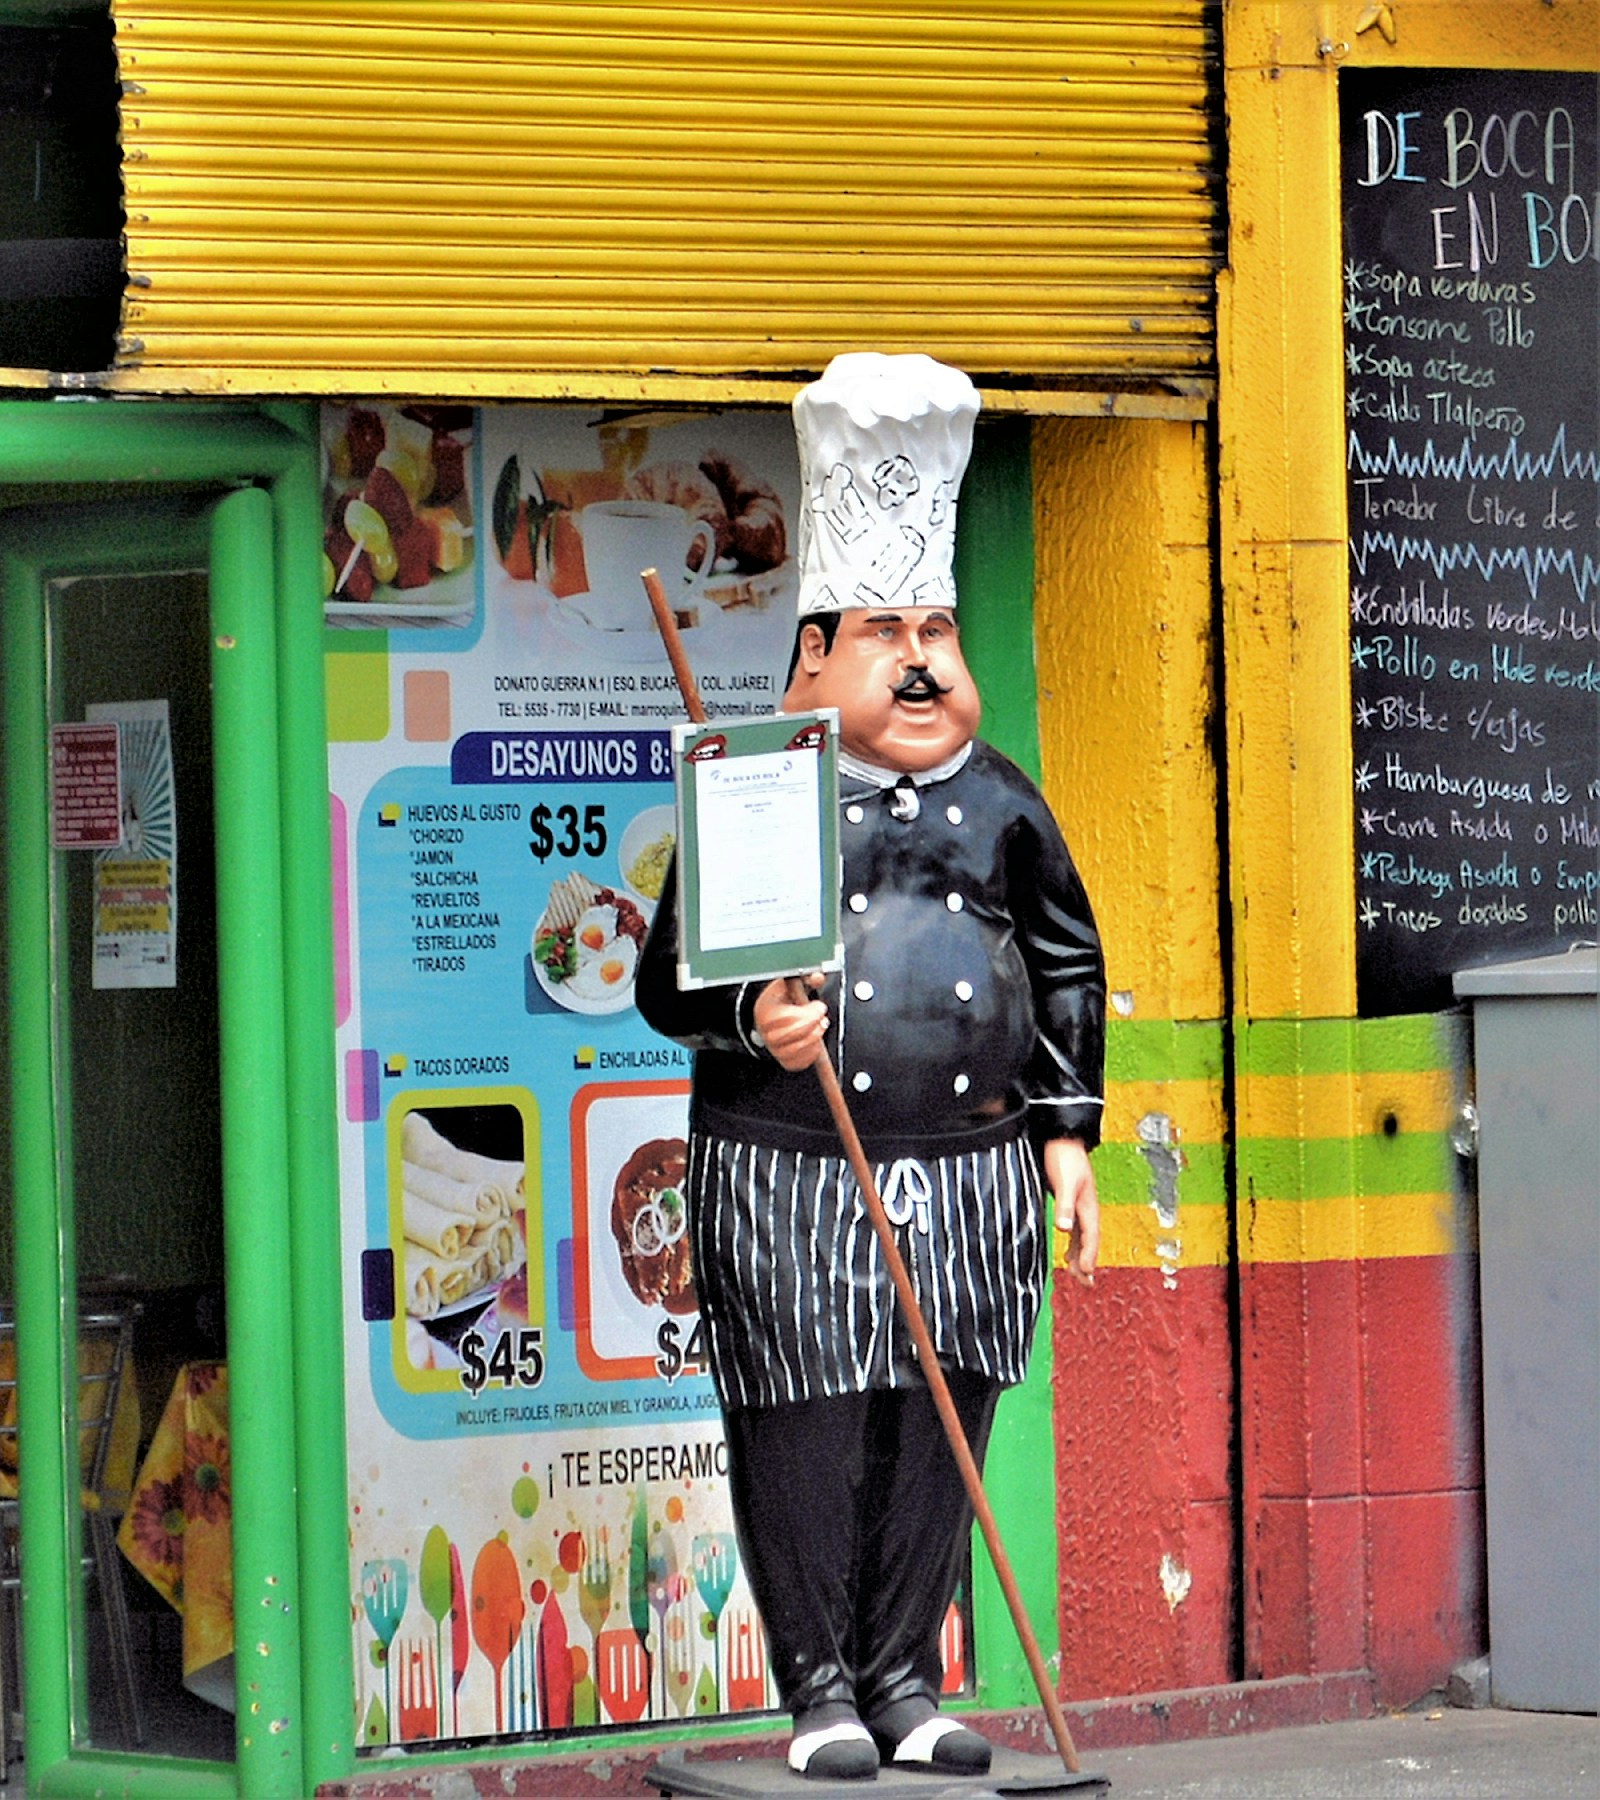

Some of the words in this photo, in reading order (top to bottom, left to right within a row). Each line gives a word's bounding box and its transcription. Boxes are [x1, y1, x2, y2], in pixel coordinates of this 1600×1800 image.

[1357, 109, 1426, 187] DE
[1440, 107, 1574, 195] BOCA
[1430, 191, 1499, 273] EN
[1522, 191, 1600, 269] BO
[1431, 275, 1537, 304] verduras
[1482, 305, 1535, 349] Pollo
[1423, 351, 1496, 387] azteca
[1354, 477, 1438, 521] Tenedor
[1543, 487, 1578, 530] de
[494, 676, 539, 692] DONATO
[541, 676, 585, 692] GUERRA
[728, 672, 769, 690] JUÁREZ
[1449, 659, 1478, 681] en
[498, 703, 521, 717] TEL:
[524, 702, 549, 717] 5535
[557, 702, 581, 717] 7730
[491, 738, 638, 777] DESAYUNOS
[1541, 767, 1572, 805] de
[408, 805, 458, 822] HUEVOS
[460, 805, 476, 821] AL
[480, 803, 521, 820] GUSTO
[1450, 809, 1513, 842] Asada
[529, 803, 607, 864] $35
[1460, 852, 1519, 889] Asada
[426, 914, 441, 929] LA
[443, 913, 500, 929] MEXICANA
[414, 1058, 451, 1076] TACOS
[454, 1056, 509, 1075] DORADOS
[600, 1050, 669, 1069] ENCHILADAS
[670, 1049, 685, 1066] AL
[461, 1330, 543, 1397] $45
[456, 1408, 501, 1426] INCLUYE:
[554, 1402, 585, 1418] FRUTA
[586, 1401, 608, 1417] CON
[610, 1400, 632, 1415] MIEL
[635, 1399, 642, 1413] Y
[562, 1452, 590, 1488] TE
